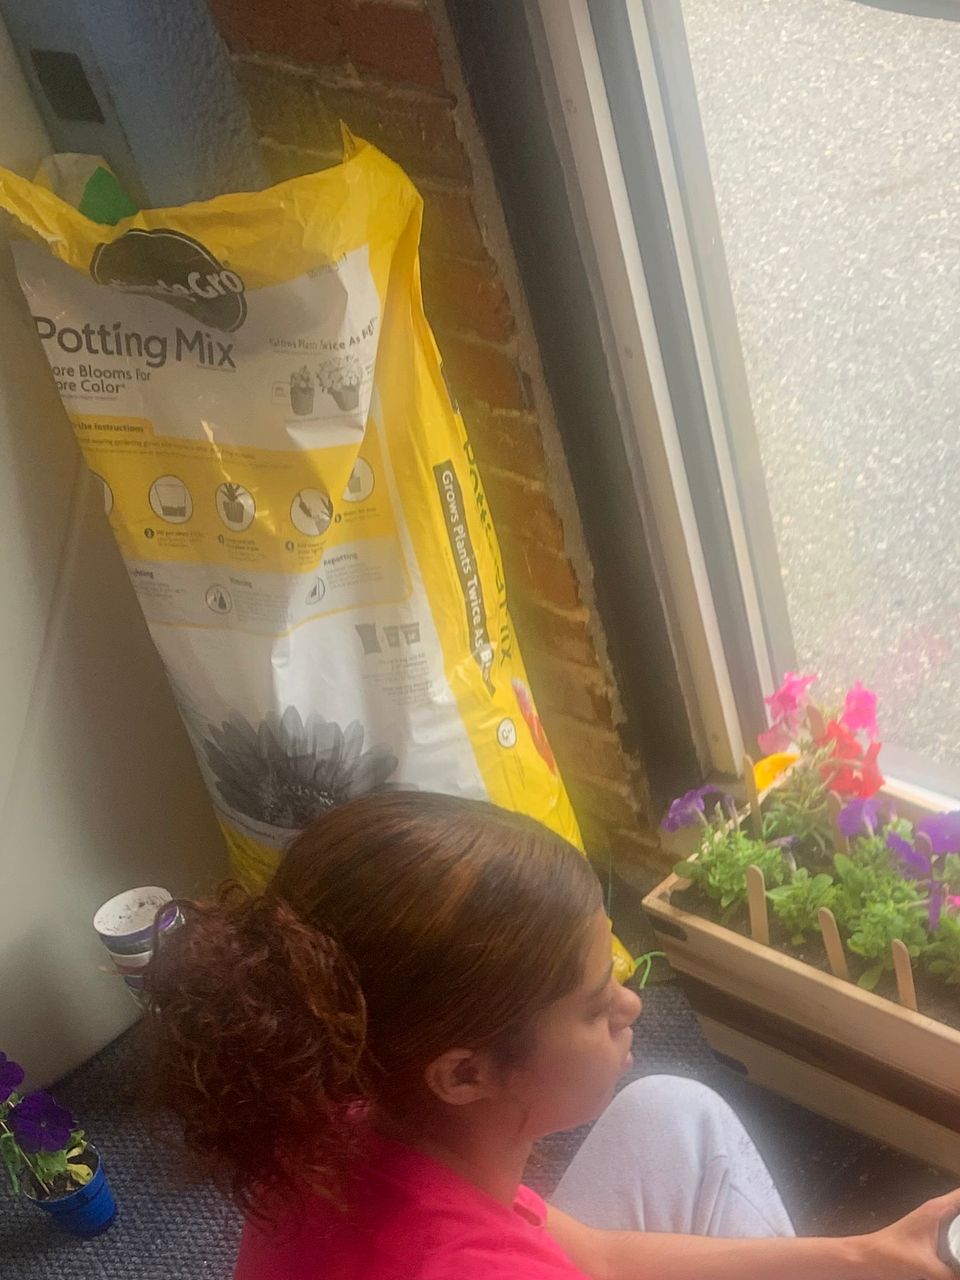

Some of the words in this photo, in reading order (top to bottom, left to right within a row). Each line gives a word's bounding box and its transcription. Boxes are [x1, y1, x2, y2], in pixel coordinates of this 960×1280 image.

[32, 316, 168, 368] Potting
[176, 327, 236, 368] Mix
[51, 365, 75, 378] ore
[79, 364, 132, 380] Blooms
[56, 380, 78, 391] ore
[441, 470, 459, 522] Grows
[453, 524, 473, 575] Plants
[466, 575, 483, 625] Twice
[474, 626, 484, 649] As
